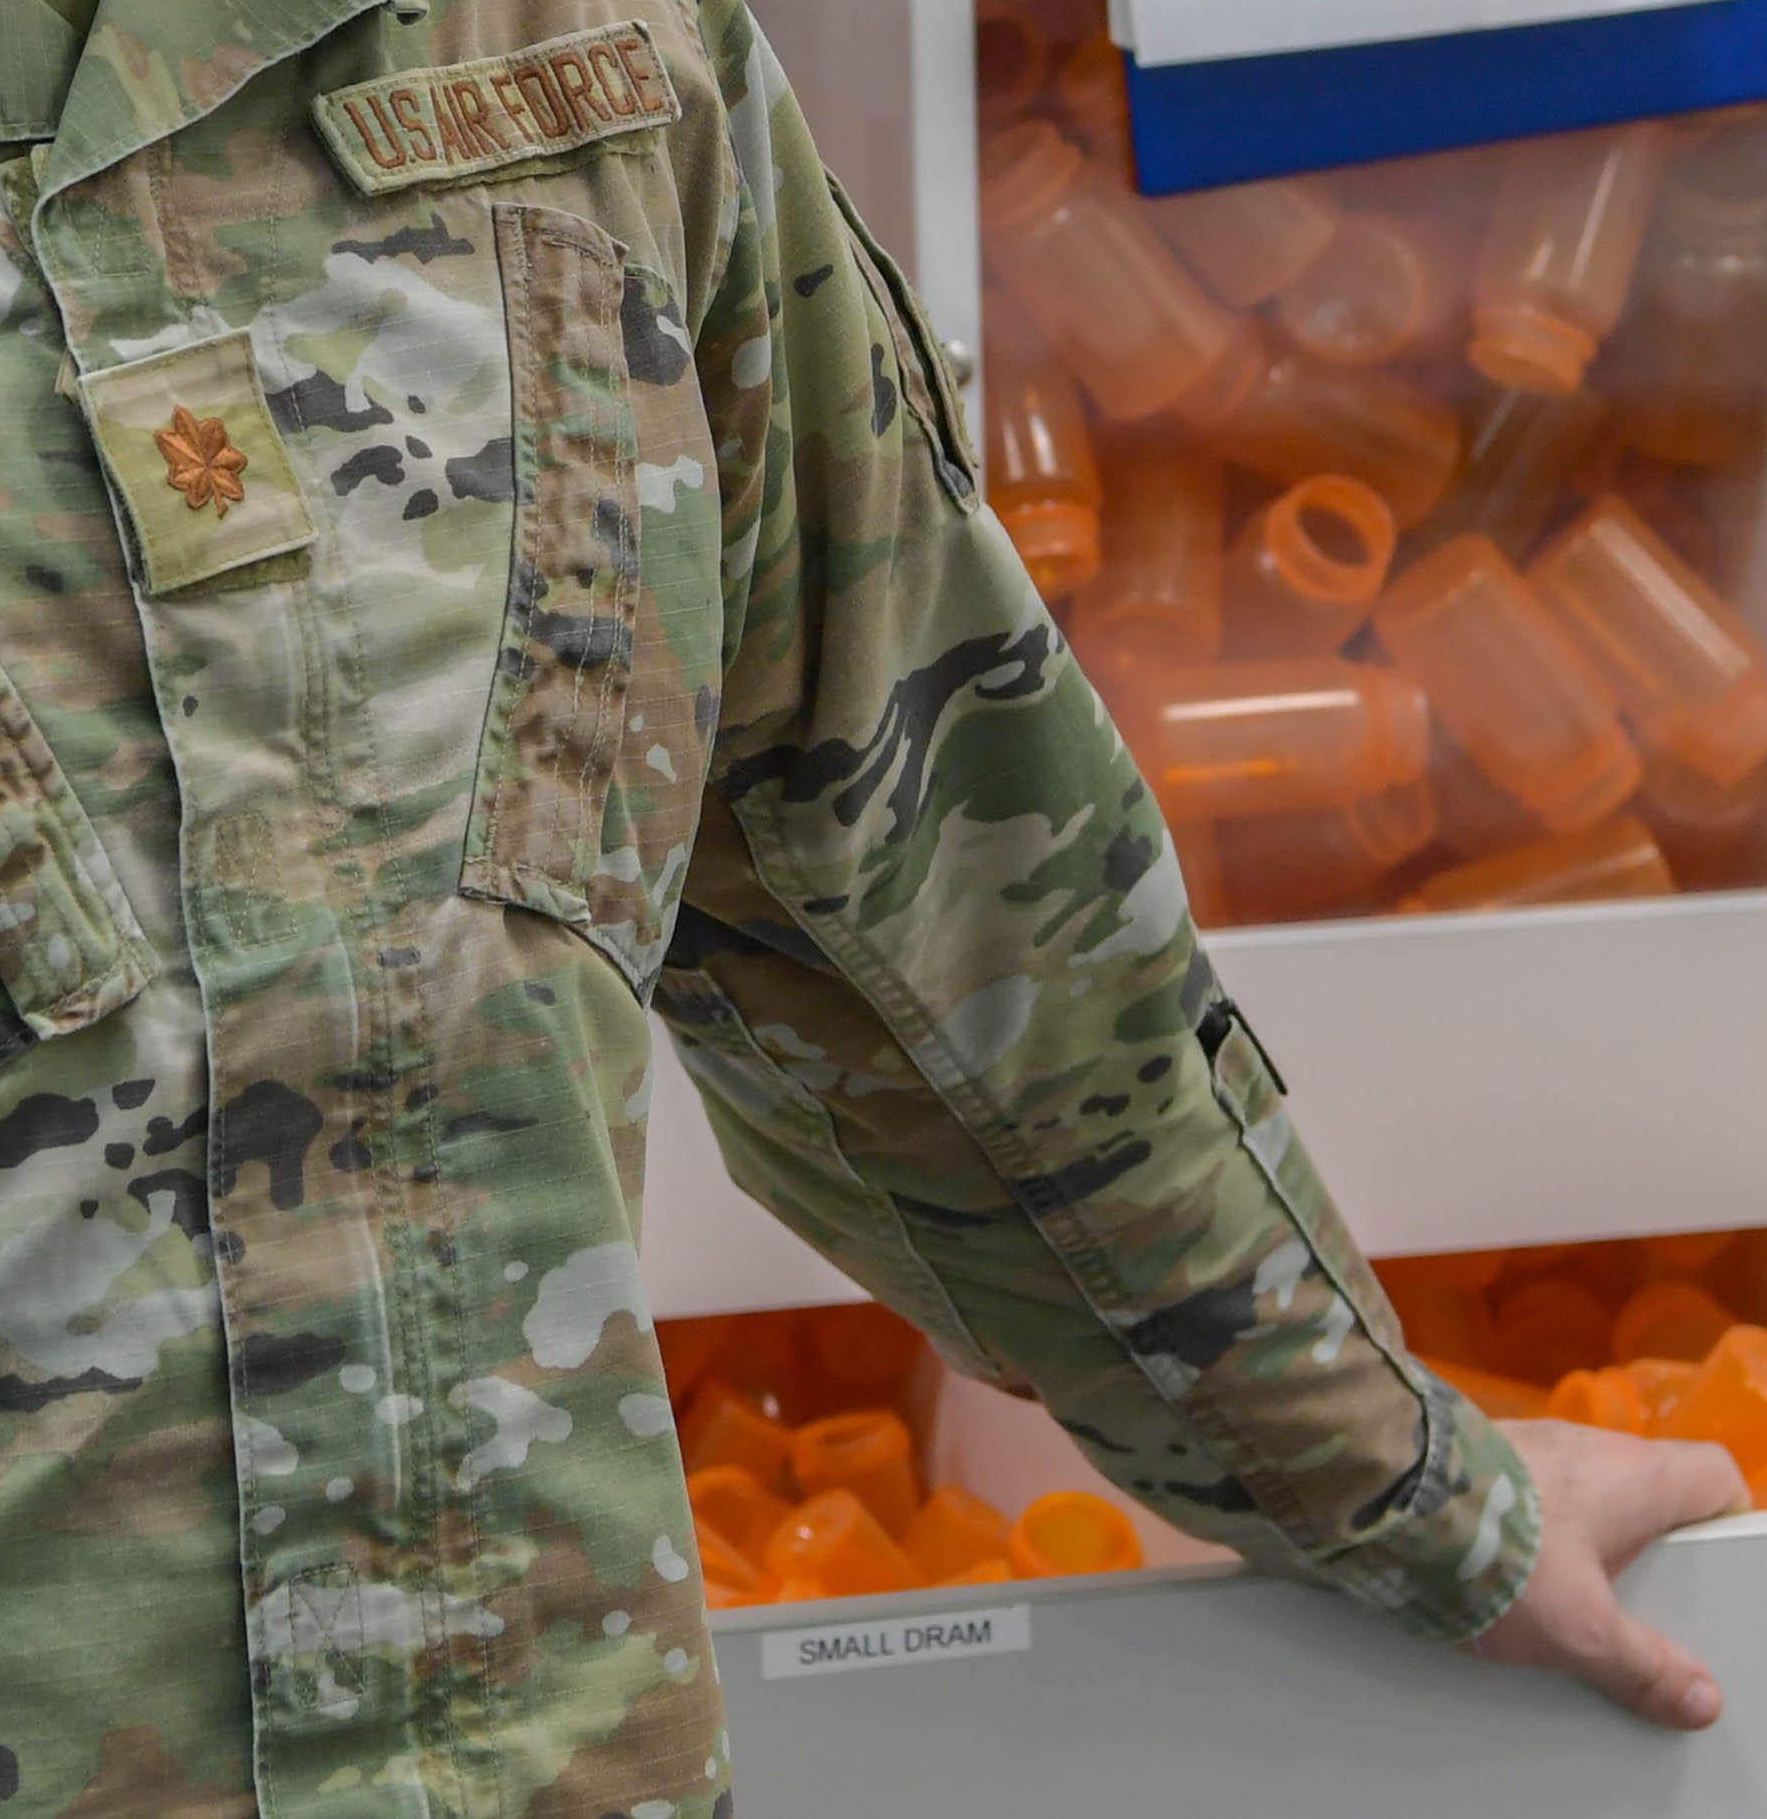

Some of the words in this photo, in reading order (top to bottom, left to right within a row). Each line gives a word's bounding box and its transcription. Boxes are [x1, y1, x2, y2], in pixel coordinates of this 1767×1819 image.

[429, 81, 511, 166] AIR
[490, 38, 665, 144] FORCE
[799, 1631, 894, 1665] SMALL
[904, 1620, 992, 1653] DRAM
